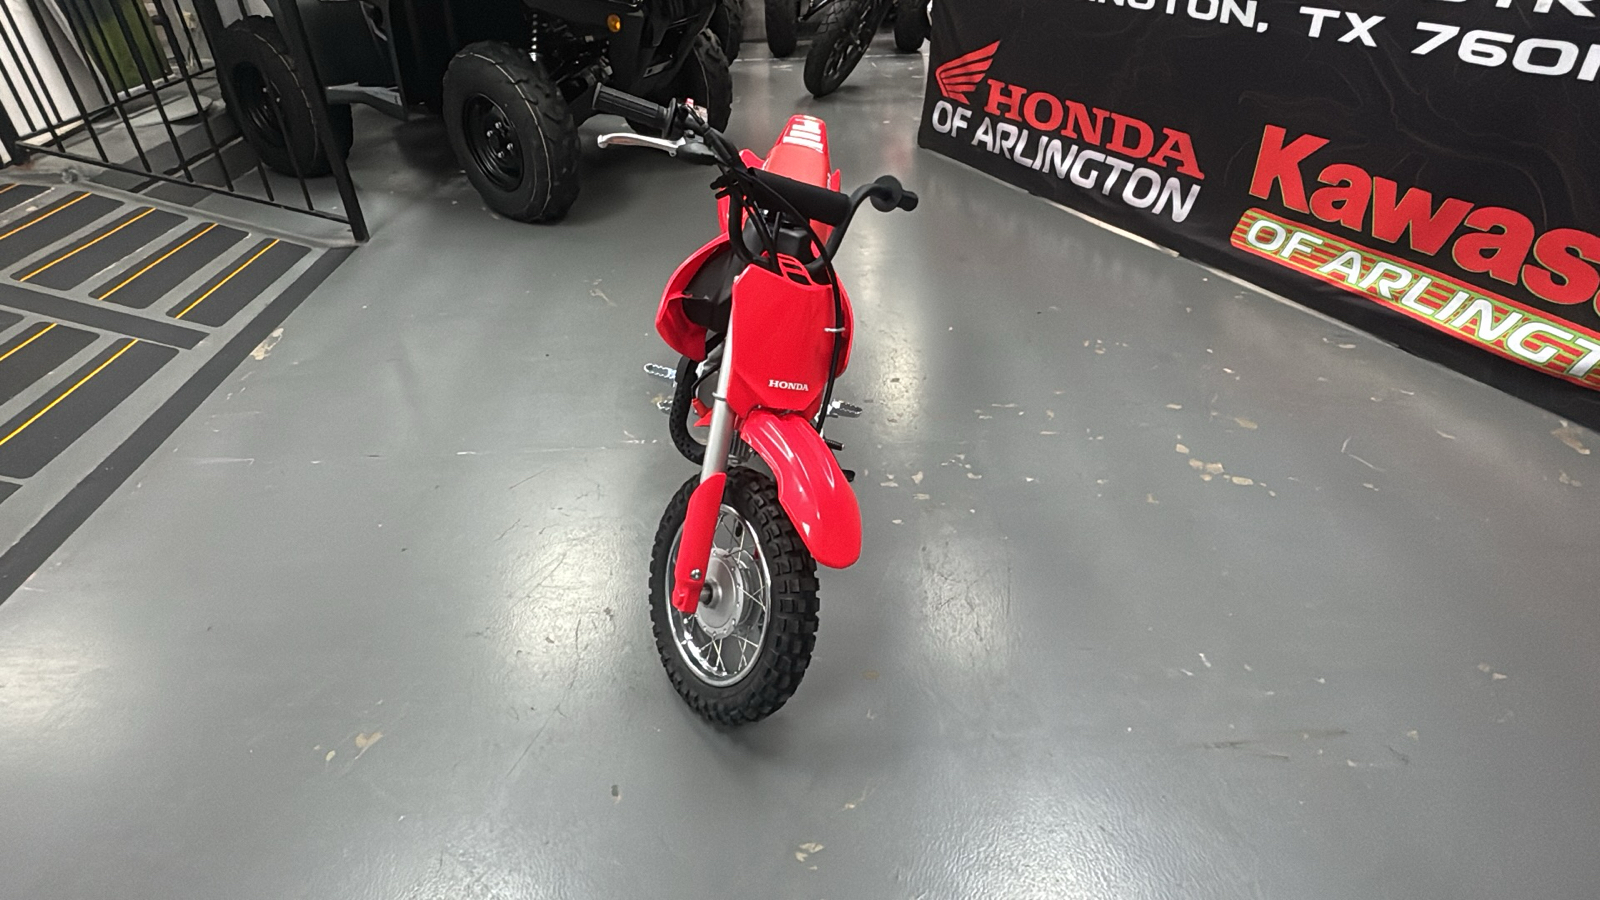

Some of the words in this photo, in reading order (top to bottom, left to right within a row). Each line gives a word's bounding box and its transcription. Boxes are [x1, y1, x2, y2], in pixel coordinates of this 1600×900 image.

[1299, 5, 1386, 48] TX
[932, 100, 972, 138] OF
[971, 117, 1202, 223] ARLINGTON
[984, 78, 1205, 180] HONDA
[1245, 218, 1324, 261] OF
[1249, 124, 1600, 318] Kawas
[768, 379, 809, 392] HONDA
